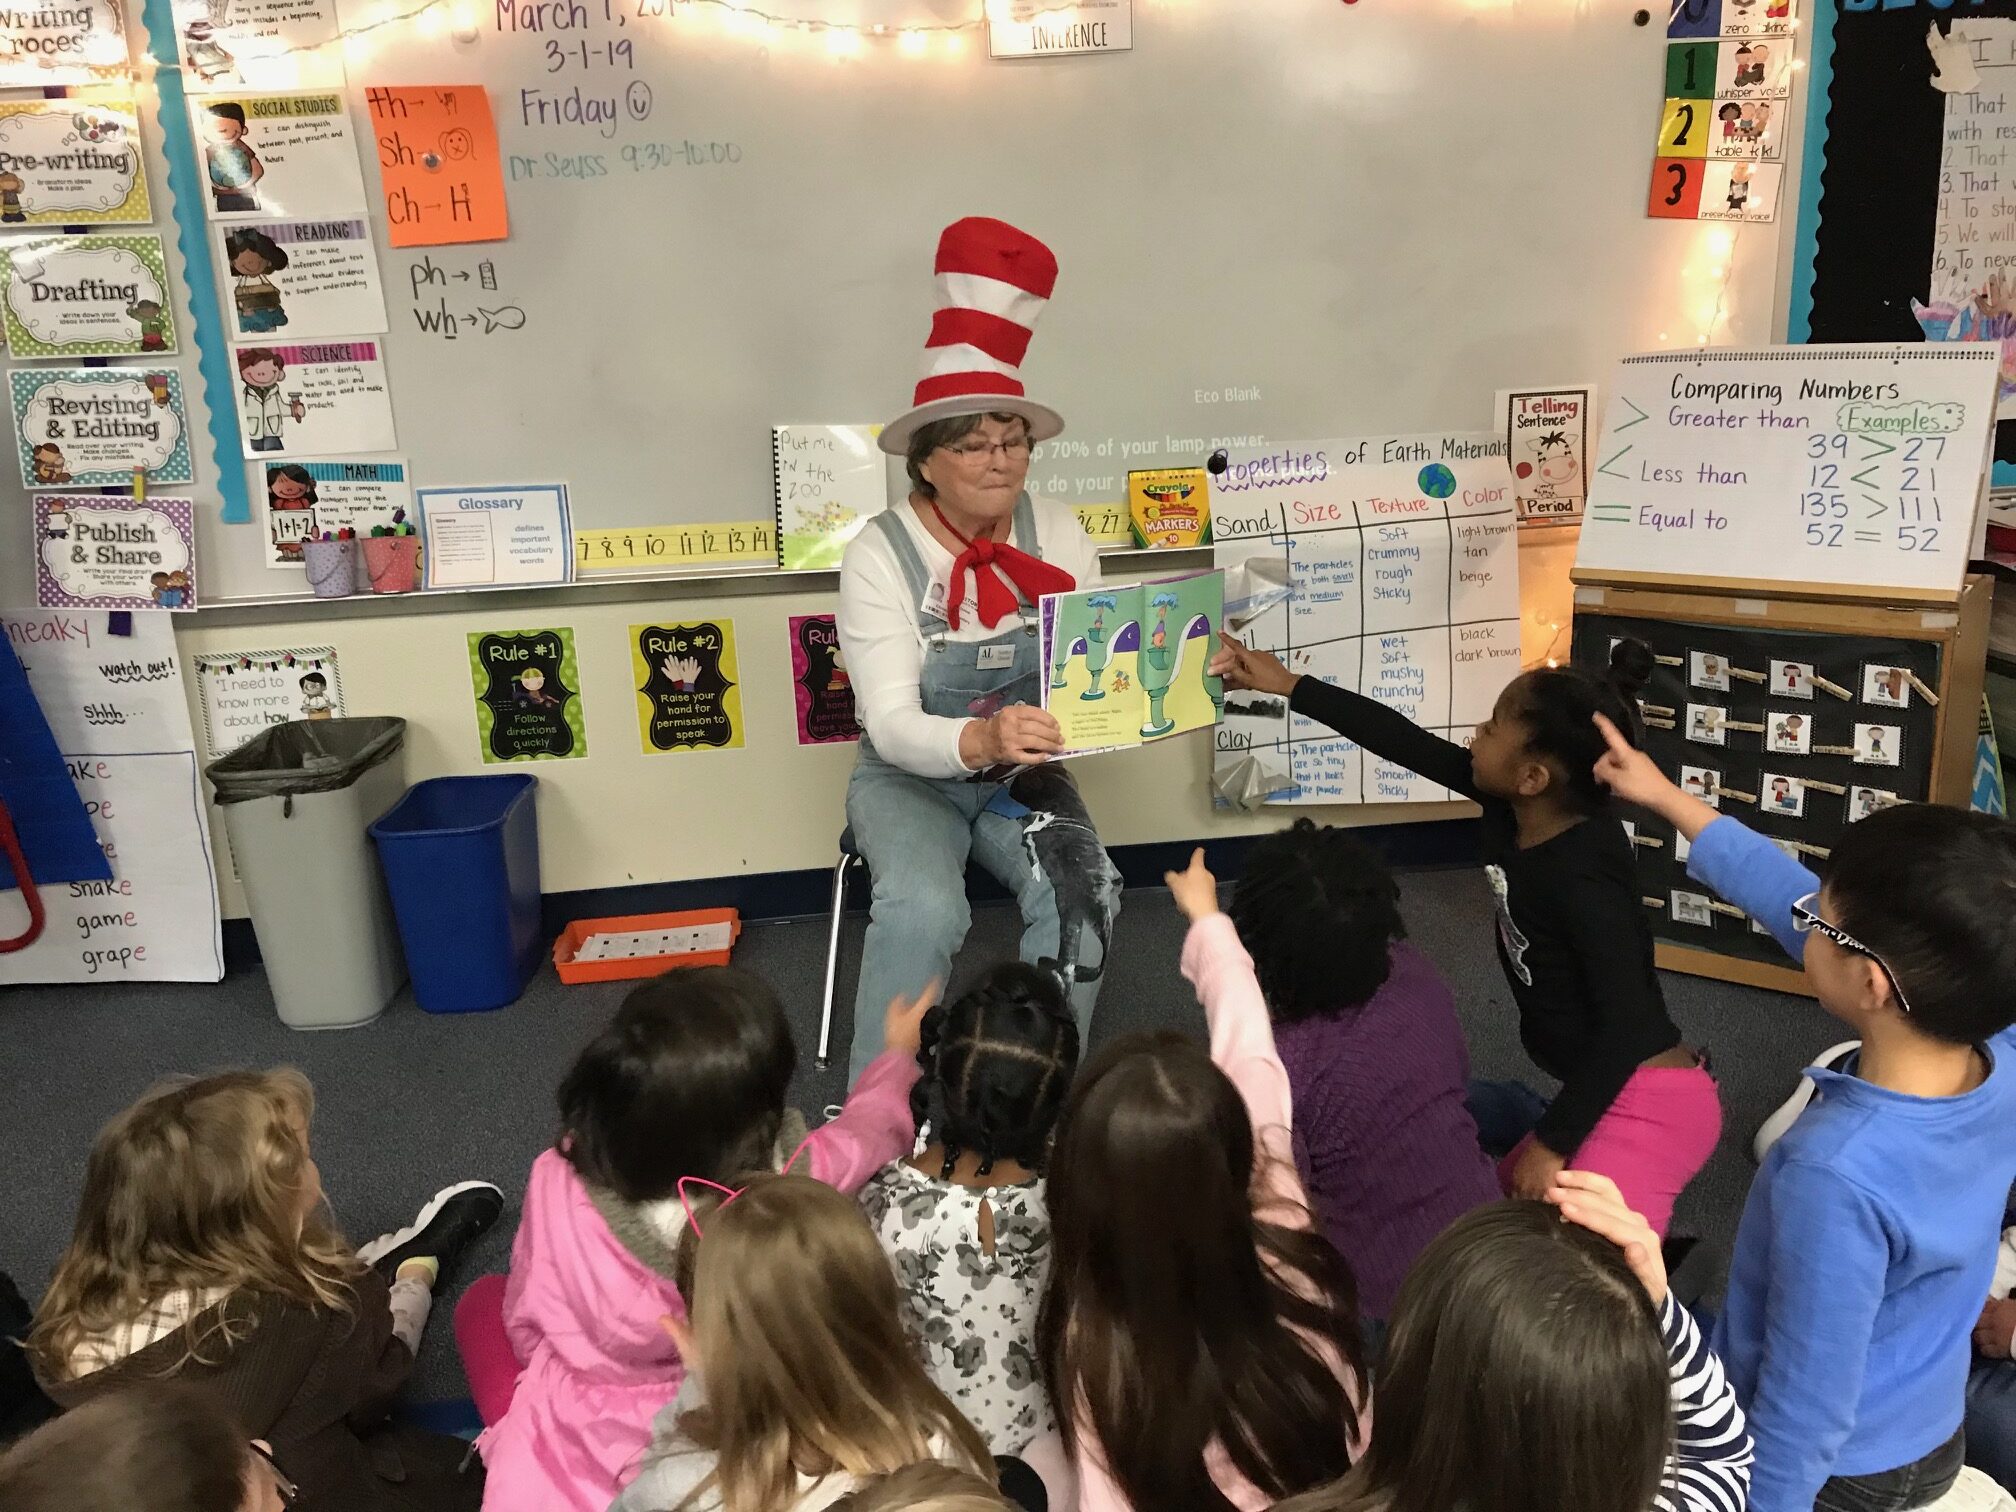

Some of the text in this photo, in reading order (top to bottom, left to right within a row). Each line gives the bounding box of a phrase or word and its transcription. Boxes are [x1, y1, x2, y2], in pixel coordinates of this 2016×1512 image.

[496, 0, 588, 31] March
[545, 39, 633, 72] 3-1-19
[1684, 48, 1695, 90] 1
[253, 98, 337, 117] SOCIAL STUDIES
[521, 86, 617, 139] Friday
[1964, 92, 2007, 115] That
[1672, 104, 1693, 146] 2
[1947, 120, 1982, 141] with
[0, 146, 130, 175] Pre-writing
[1715, 146, 1742, 157] table
[545, 152, 609, 179] Seuss
[1665, 164, 1686, 206] 3
[1960, 172, 1999, 192] That
[1961, 197, 1978, 218] To
[295, 223, 350, 241] READING
[1955, 249, 1973, 269] To
[31, 279, 138, 305] Drafting
[301, 345, 352, 362] SCIENCE
[1195, 386, 1262, 404] Eco Blank
[1671, 373, 1899, 406] Comparing Numbers
[47, 394, 150, 418] Revising
[1518, 397, 1578, 419] Telling
[1517, 414, 1566, 429] Sentence
[1669, 405, 1810, 428] Greater than
[46, 418, 160, 441] & Editing
[780, 430, 835, 452] Put me
[1051, 441, 1090, 459] 70%
[1097, 438, 1114, 456] of
[1121, 439, 1159, 459] your
[1166, 434, 1209, 456] lamp
[1345, 442, 1368, 464] of
[1383, 440, 1430, 463] Earth
[1441, 438, 1507, 460] Materials
[1807, 434, 1848, 458] 39
[1903, 437, 1946, 462] 27
[345, 464, 378, 479] MATH
[805, 462, 835, 482] the
[1641, 460, 1747, 484] Less than
[1811, 464, 1839, 488] 12
[1900, 468, 1935, 491] 21
[1048, 474, 1114, 495] do your
[1147, 483, 1189, 493] Crayola
[458, 497, 524, 511] Glossary
[1366, 498, 1430, 515] Texture
[1463, 486, 1508, 507] Color
[1527, 499, 1573, 514] Period
[1801, 492, 1848, 518] 135
[1293, 501, 1341, 524] Size
[1639, 505, 1727, 532] Equal to
[1899, 497, 1941, 522] 111
[515, 524, 544, 532] defines
[1145, 518, 1199, 534] MARKERS
[1216, 508, 1278, 537] Sand
[74, 522, 157, 544] Publish
[511, 535, 550, 545] important
[1457, 523, 1515, 544] light brown
[1807, 523, 1843, 547] 52
[1899, 526, 1940, 551] 52
[71, 545, 162, 565] & Share
[509, 547, 553, 556] vocabulary
[577, 530, 768, 561] 7 8 9 10 11 12 13 14
[1464, 545, 1488, 558] tan
[1291, 560, 1354, 574] The particles
[1376, 564, 1413, 583] rough
[1311, 576, 1329, 584] both
[1459, 570, 1493, 588] beige
[1310, 590, 1343, 600] medium
[1380, 635, 1409, 649] wet
[1460, 627, 1495, 641] black
[490, 642, 557, 662] Rule #1
[649, 635, 718, 654] Rule #2
[1455, 647, 1521, 662] dark brown
[147, 657, 176, 675] out!
[1381, 666, 1424, 683] mushy
[232, 676, 284, 690] need to
[216, 695, 290, 709] know more
[661, 692, 715, 703] Raise your
[224, 711, 289, 728] about how
[514, 714, 546, 723] Follow
[668, 704, 711, 715] hand for
[507, 726, 557, 736] directions
[657, 715, 725, 730] permission to
[1217, 730, 1252, 755] Clay
[70, 879, 132, 898] snake
[77, 911, 137, 939] game
[82, 945, 146, 974] grape
